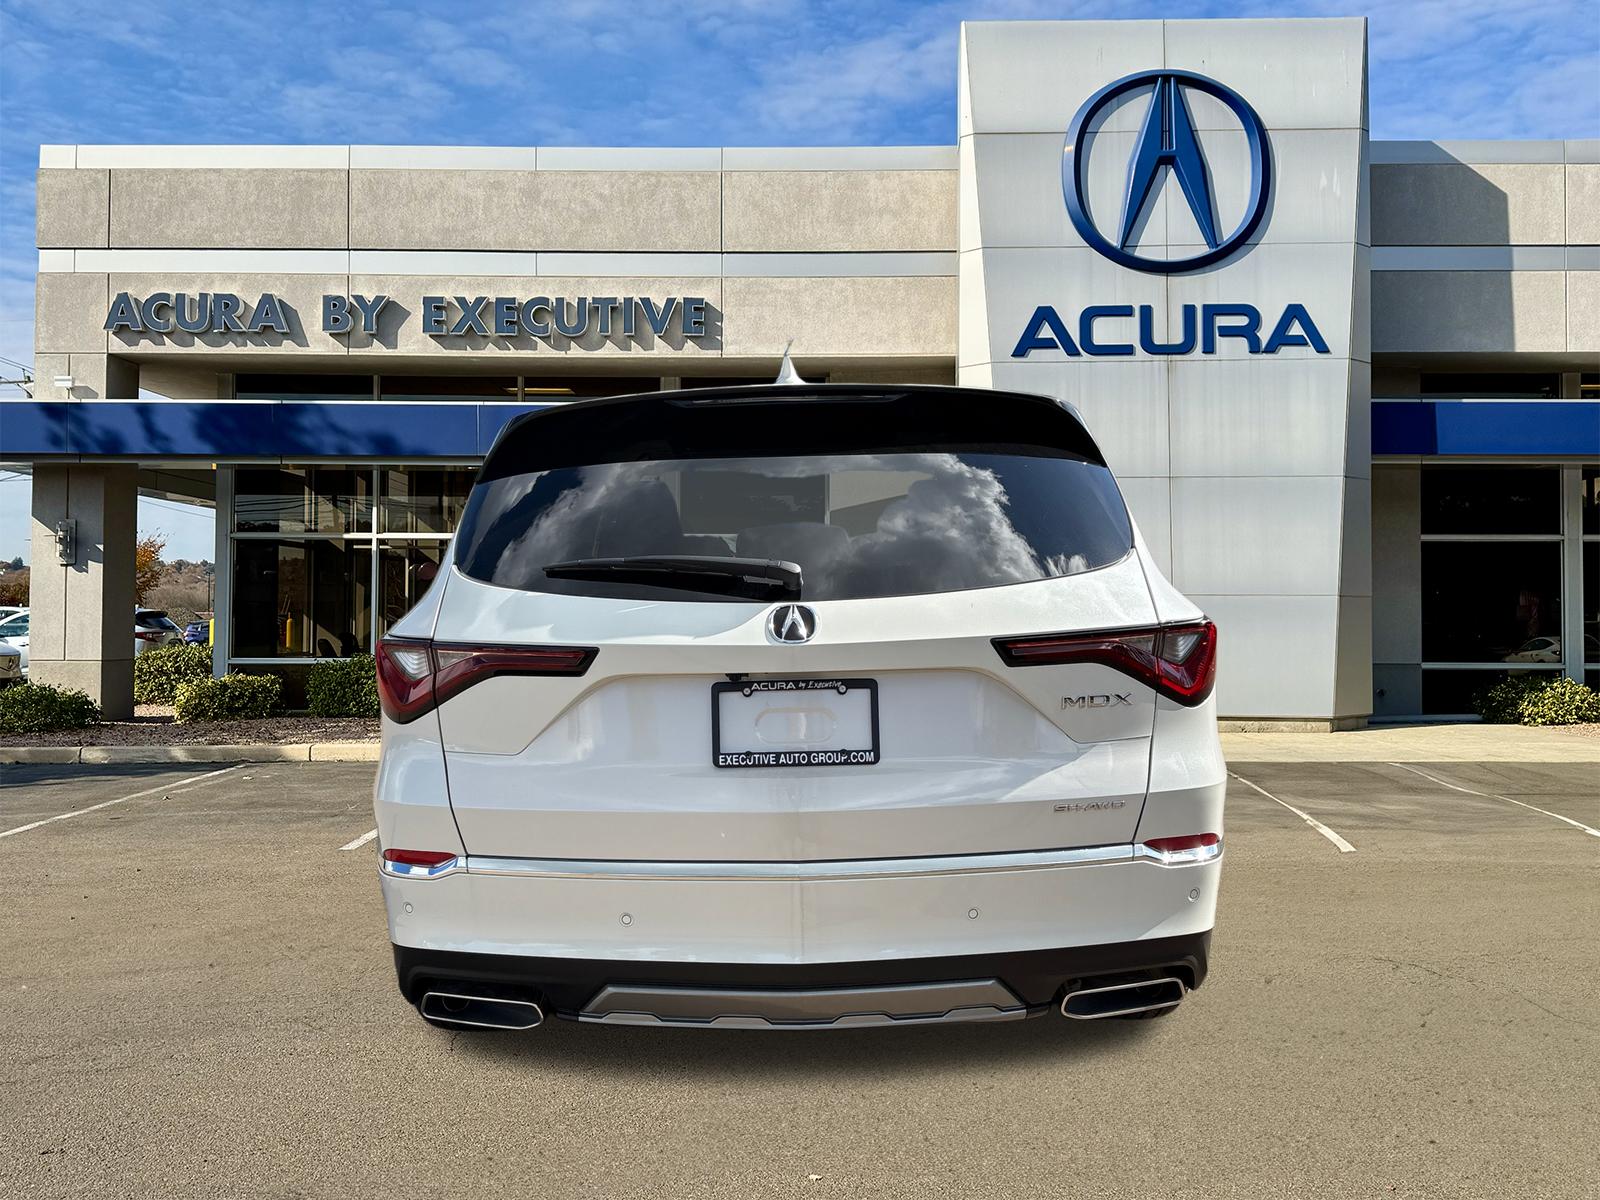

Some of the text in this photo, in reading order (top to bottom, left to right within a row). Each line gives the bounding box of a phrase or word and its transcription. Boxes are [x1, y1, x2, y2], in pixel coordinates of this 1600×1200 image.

[103, 291, 707, 337] ACURA BY EXECUTIVE
[1010, 303, 1332, 357] ACURA
[751, 681, 796, 691] ACURA
[1061, 693, 1133, 710] MDX
[719, 754, 777, 766] EXECUTIVE
[779, 753, 808, 764] AUTO
